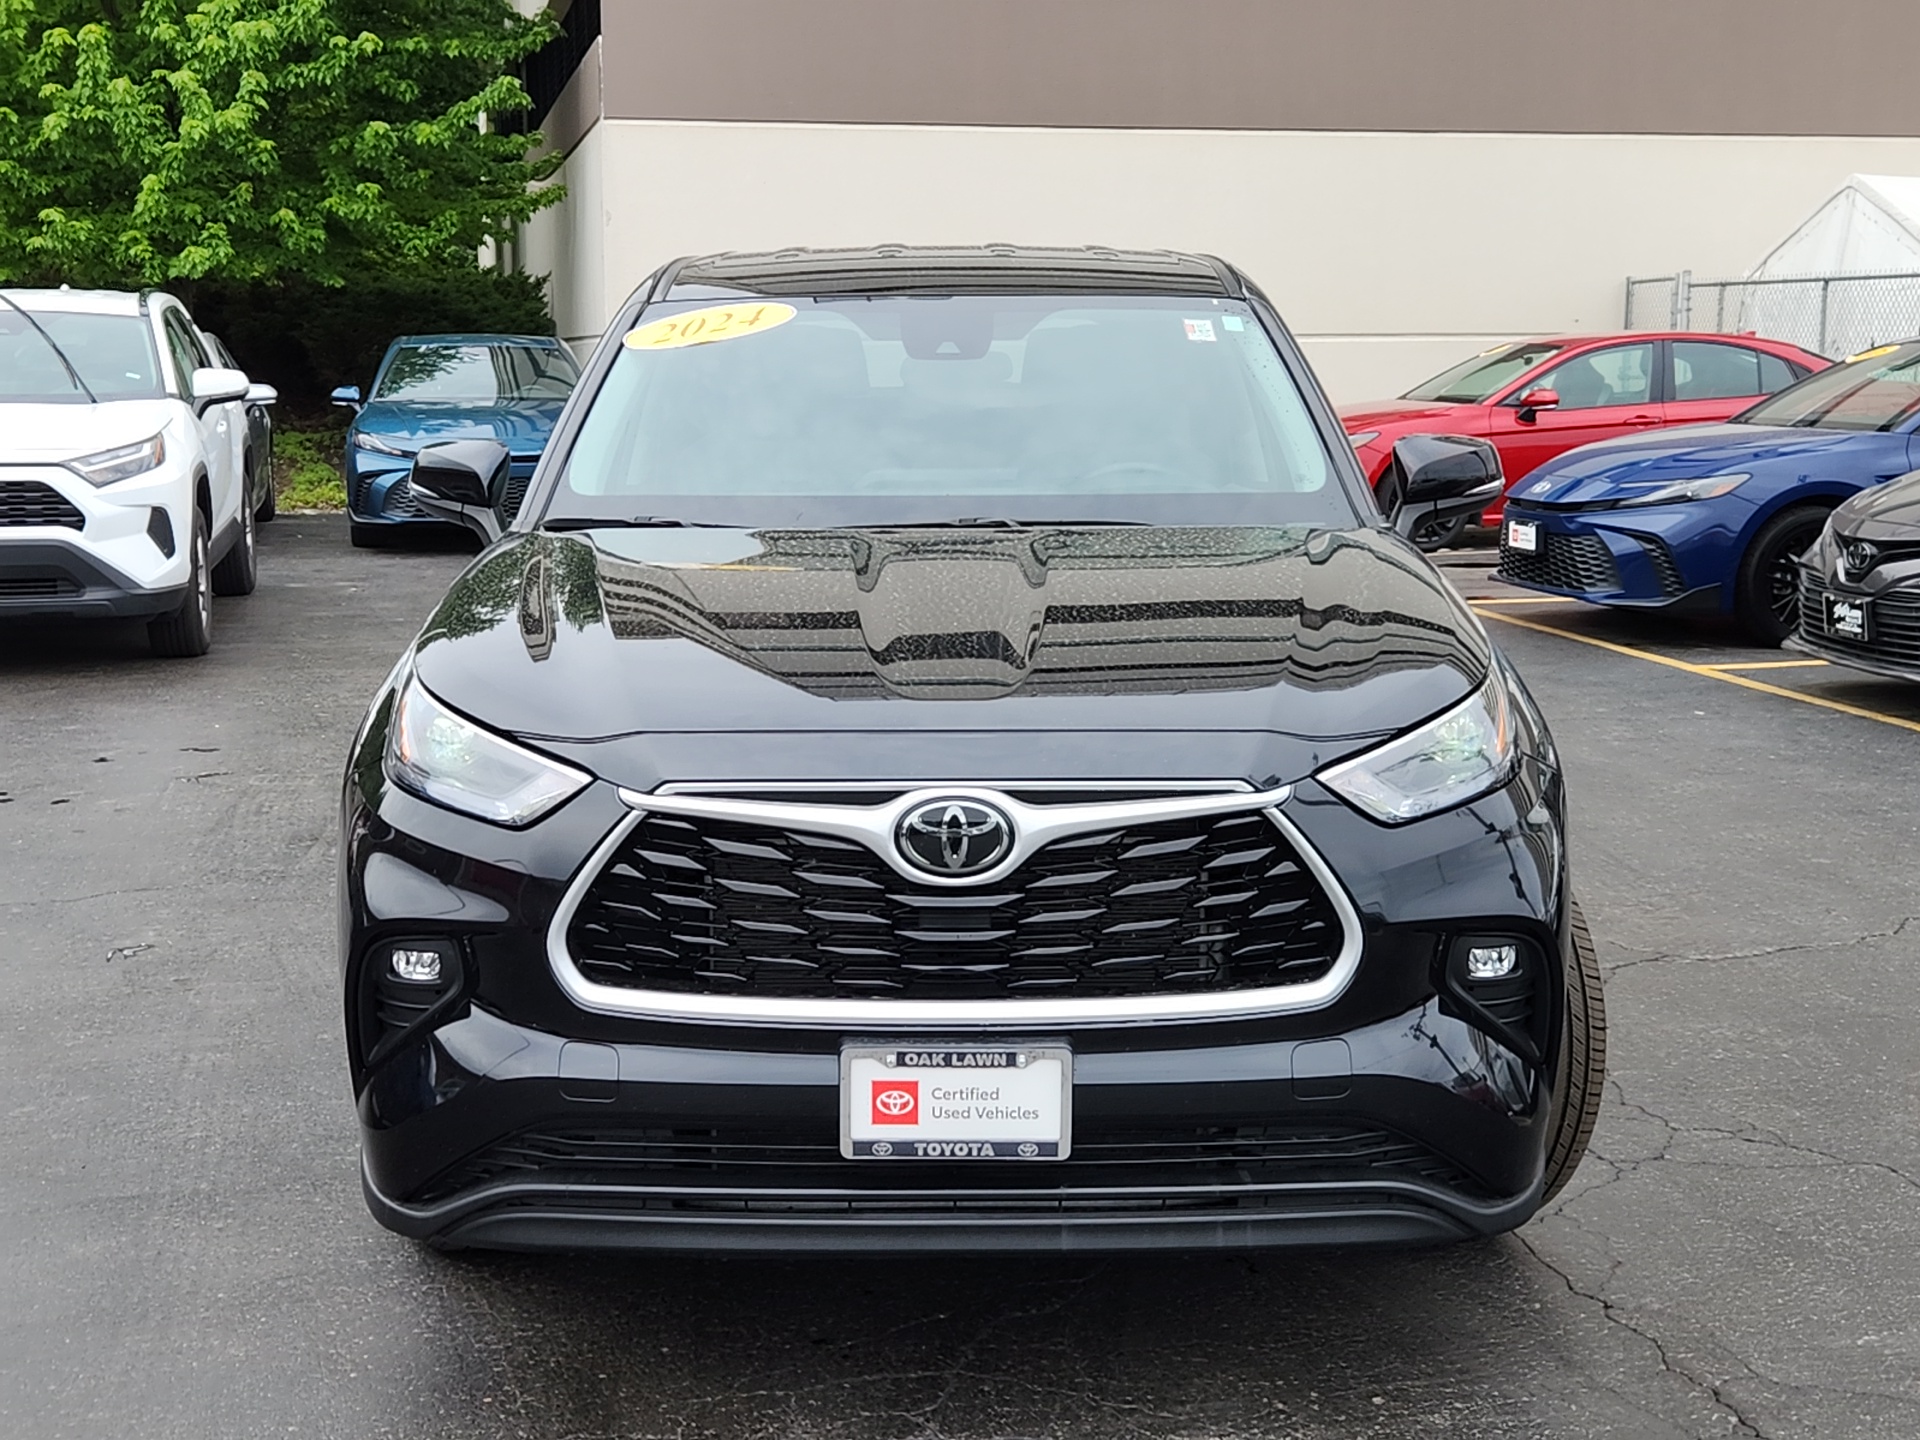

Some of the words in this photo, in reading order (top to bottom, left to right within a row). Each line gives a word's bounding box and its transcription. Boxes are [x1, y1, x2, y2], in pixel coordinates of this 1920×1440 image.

[653, 306, 766, 344] 2024
[904, 1052, 945, 1067] OAK
[951, 1052, 1007, 1067] LAWN
[931, 1087, 1000, 1101] Certified
[931, 1106, 971, 1119] Used
[975, 1106, 1039, 1119] Vehicles
[913, 1142, 995, 1157] TOYOTA
